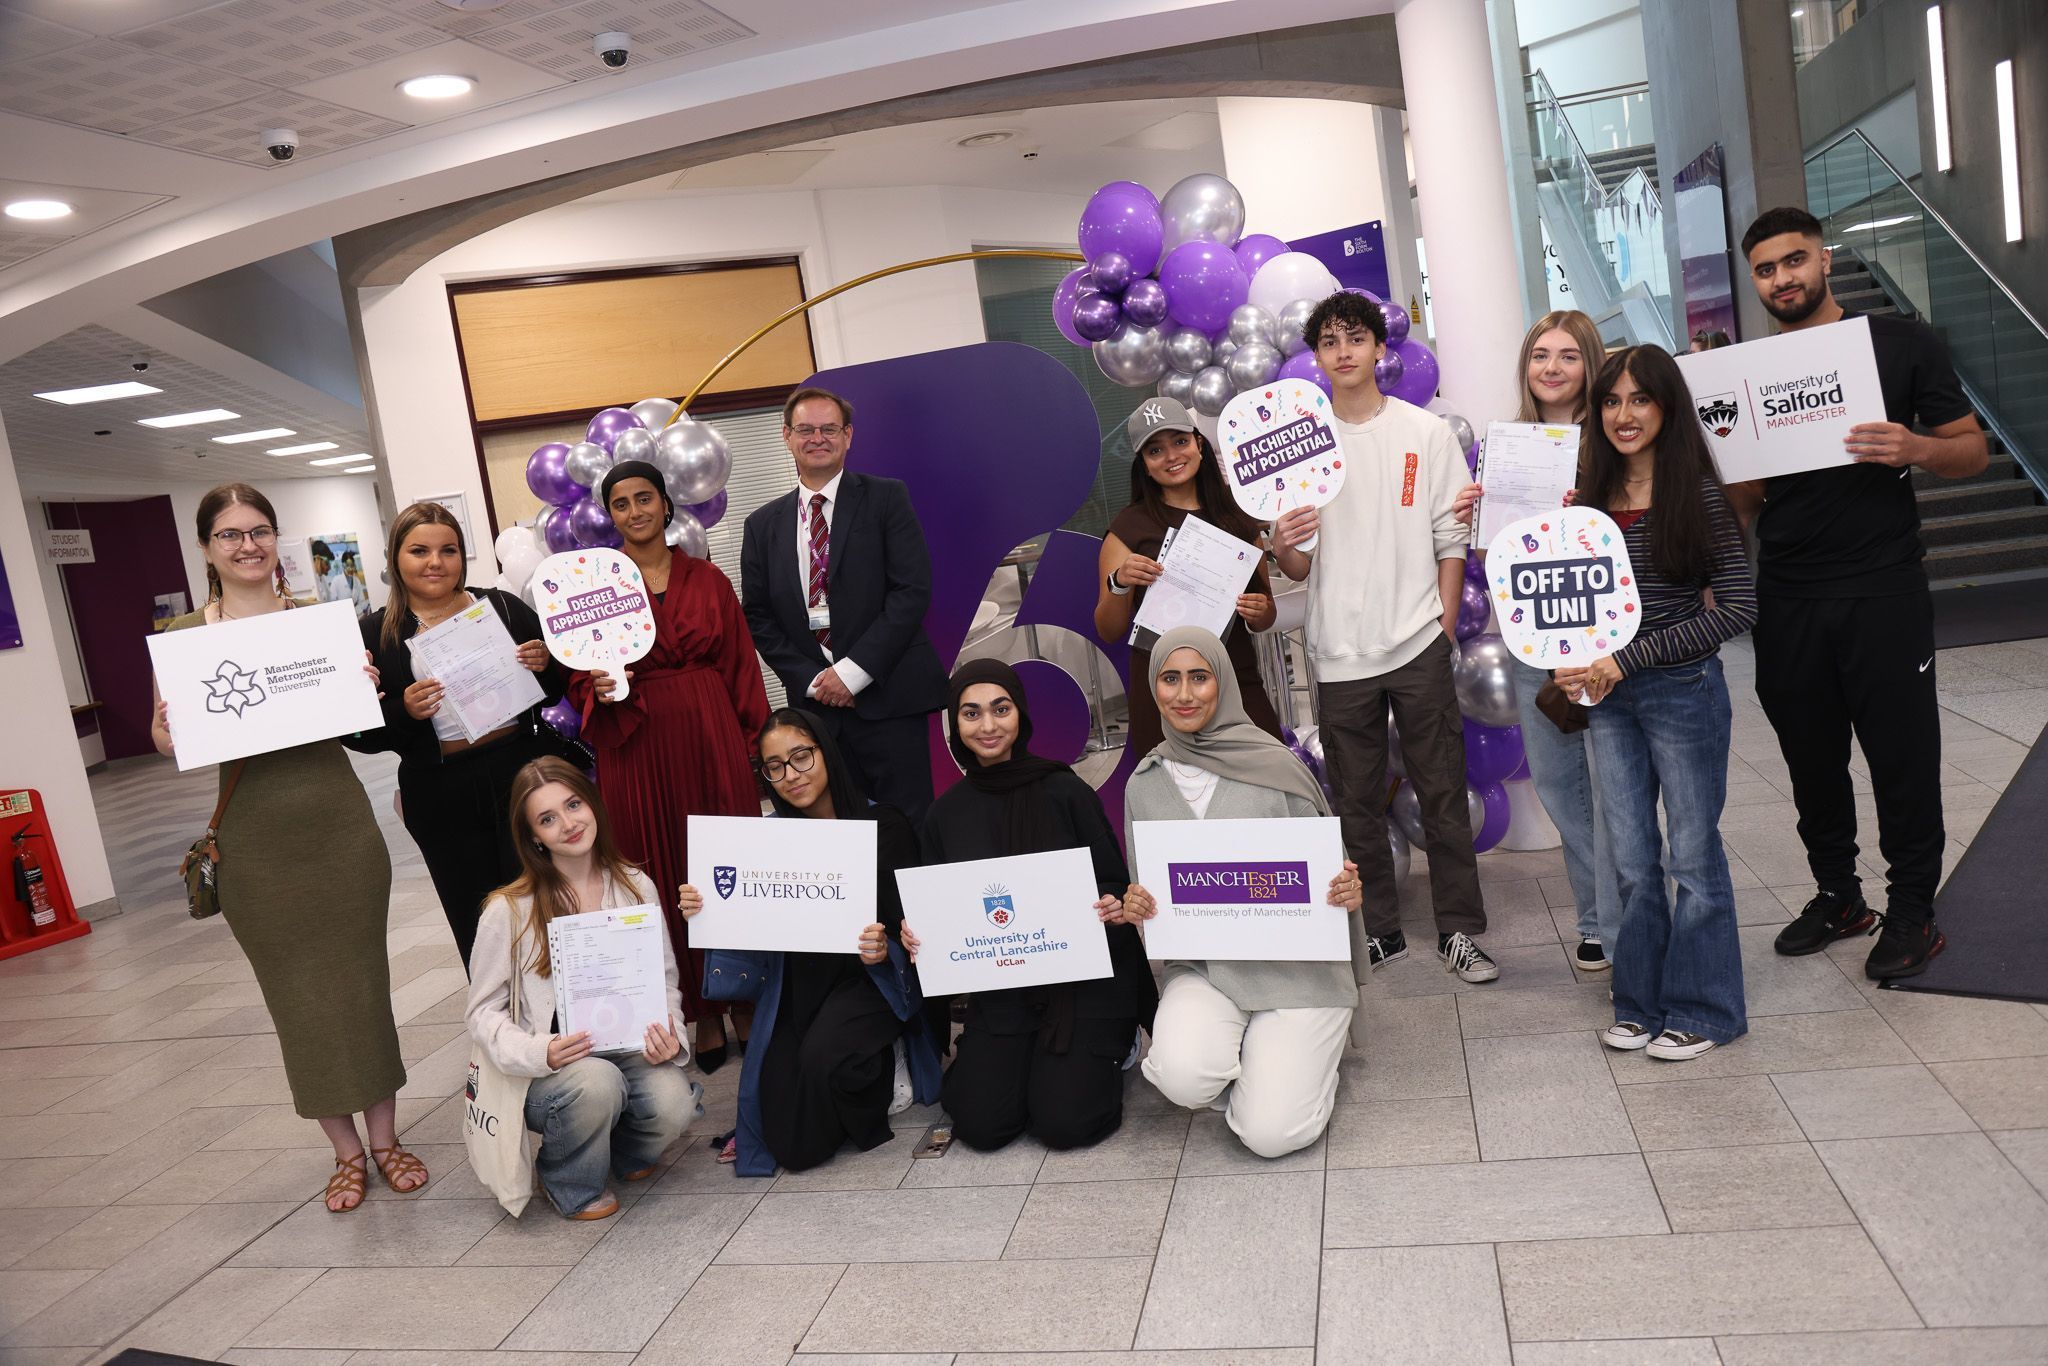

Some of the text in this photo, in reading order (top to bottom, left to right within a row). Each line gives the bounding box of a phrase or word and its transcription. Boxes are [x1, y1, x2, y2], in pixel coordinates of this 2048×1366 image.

[1760, 370, 1838, 397] University of
[1763, 383, 1844, 417] Salford
[1143, 404, 1166, 426] NY
[1766, 406, 1847, 430] MANCHESTER
[1242, 421, 1314, 461] I ACHIEVED
[1238, 432, 1332, 481] MY POTENTIAL
[51, 534, 80, 545] STUDENT
[48, 546, 90, 558] INFORMATION
[1516, 564, 1609, 595] OFF TO
[570, 590, 615, 611] DEGREE
[1541, 596, 1588, 624] UNI
[552, 595, 642, 632] APPRENTICESHIP
[264, 657, 328, 676] Manchester
[267, 665, 337, 685] Metropolitan
[269, 678, 321, 694] University
[742, 870, 843, 881] UNIVERSITY OF
[1176, 871, 1304, 887] MANCHESTER
[742, 882, 846, 900] LIVERPOOL
[1248, 886, 1278, 899] 1824
[1172, 907, 1312, 921] The University of Manchester
[965, 928, 1046, 948] University of
[950, 940, 1068, 962] Central Lancashire
[996, 958, 1026, 967] UCLan
